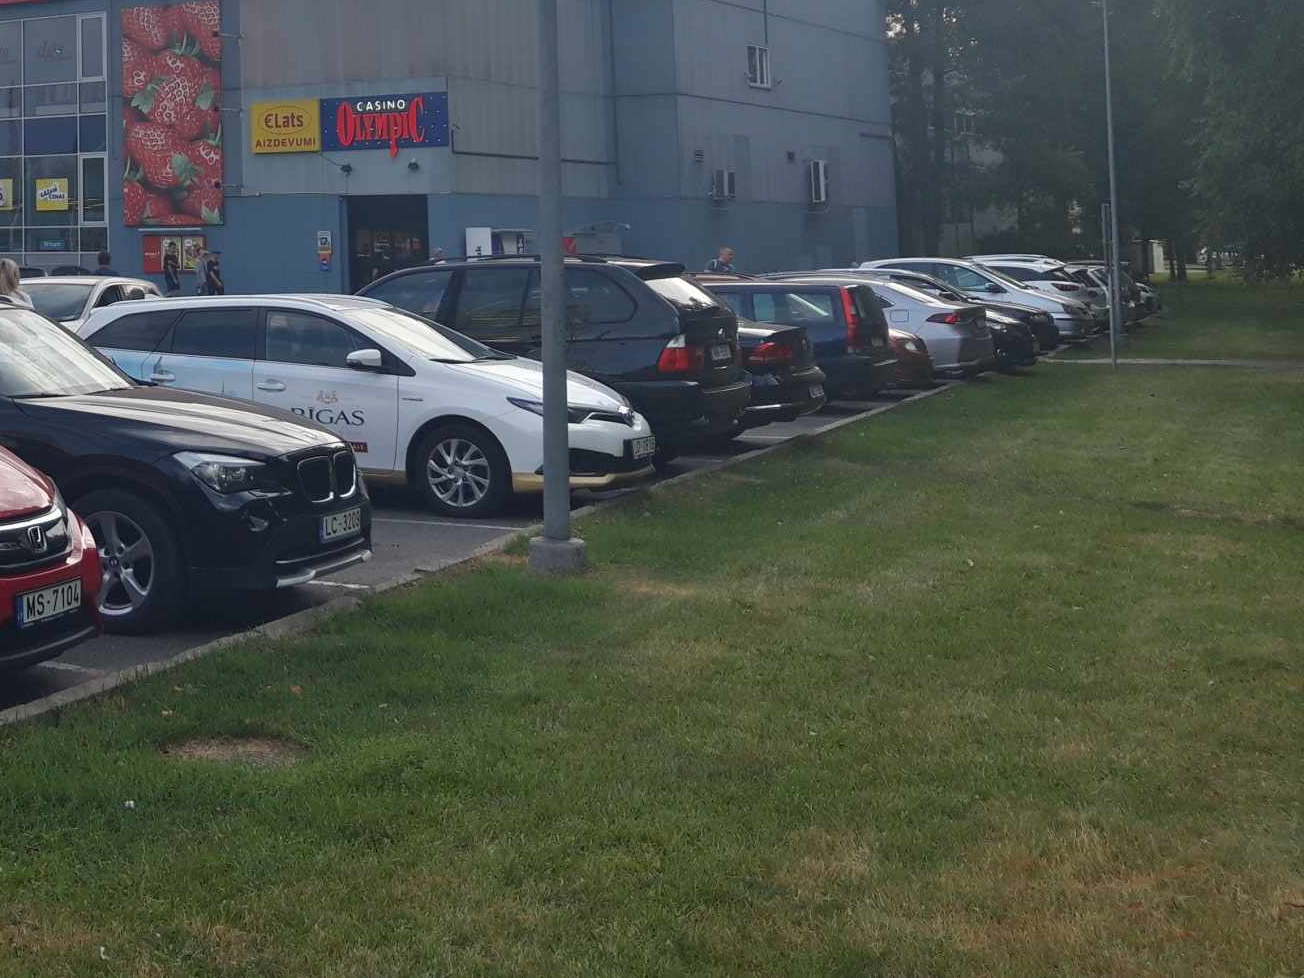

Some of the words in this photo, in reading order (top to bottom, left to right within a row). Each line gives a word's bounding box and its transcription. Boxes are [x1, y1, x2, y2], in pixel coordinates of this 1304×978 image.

[357, 99, 406, 115] CASINO
[255, 137, 315, 149] AIZDEVUMI
[26, 583, 79, 619] MS-7104
